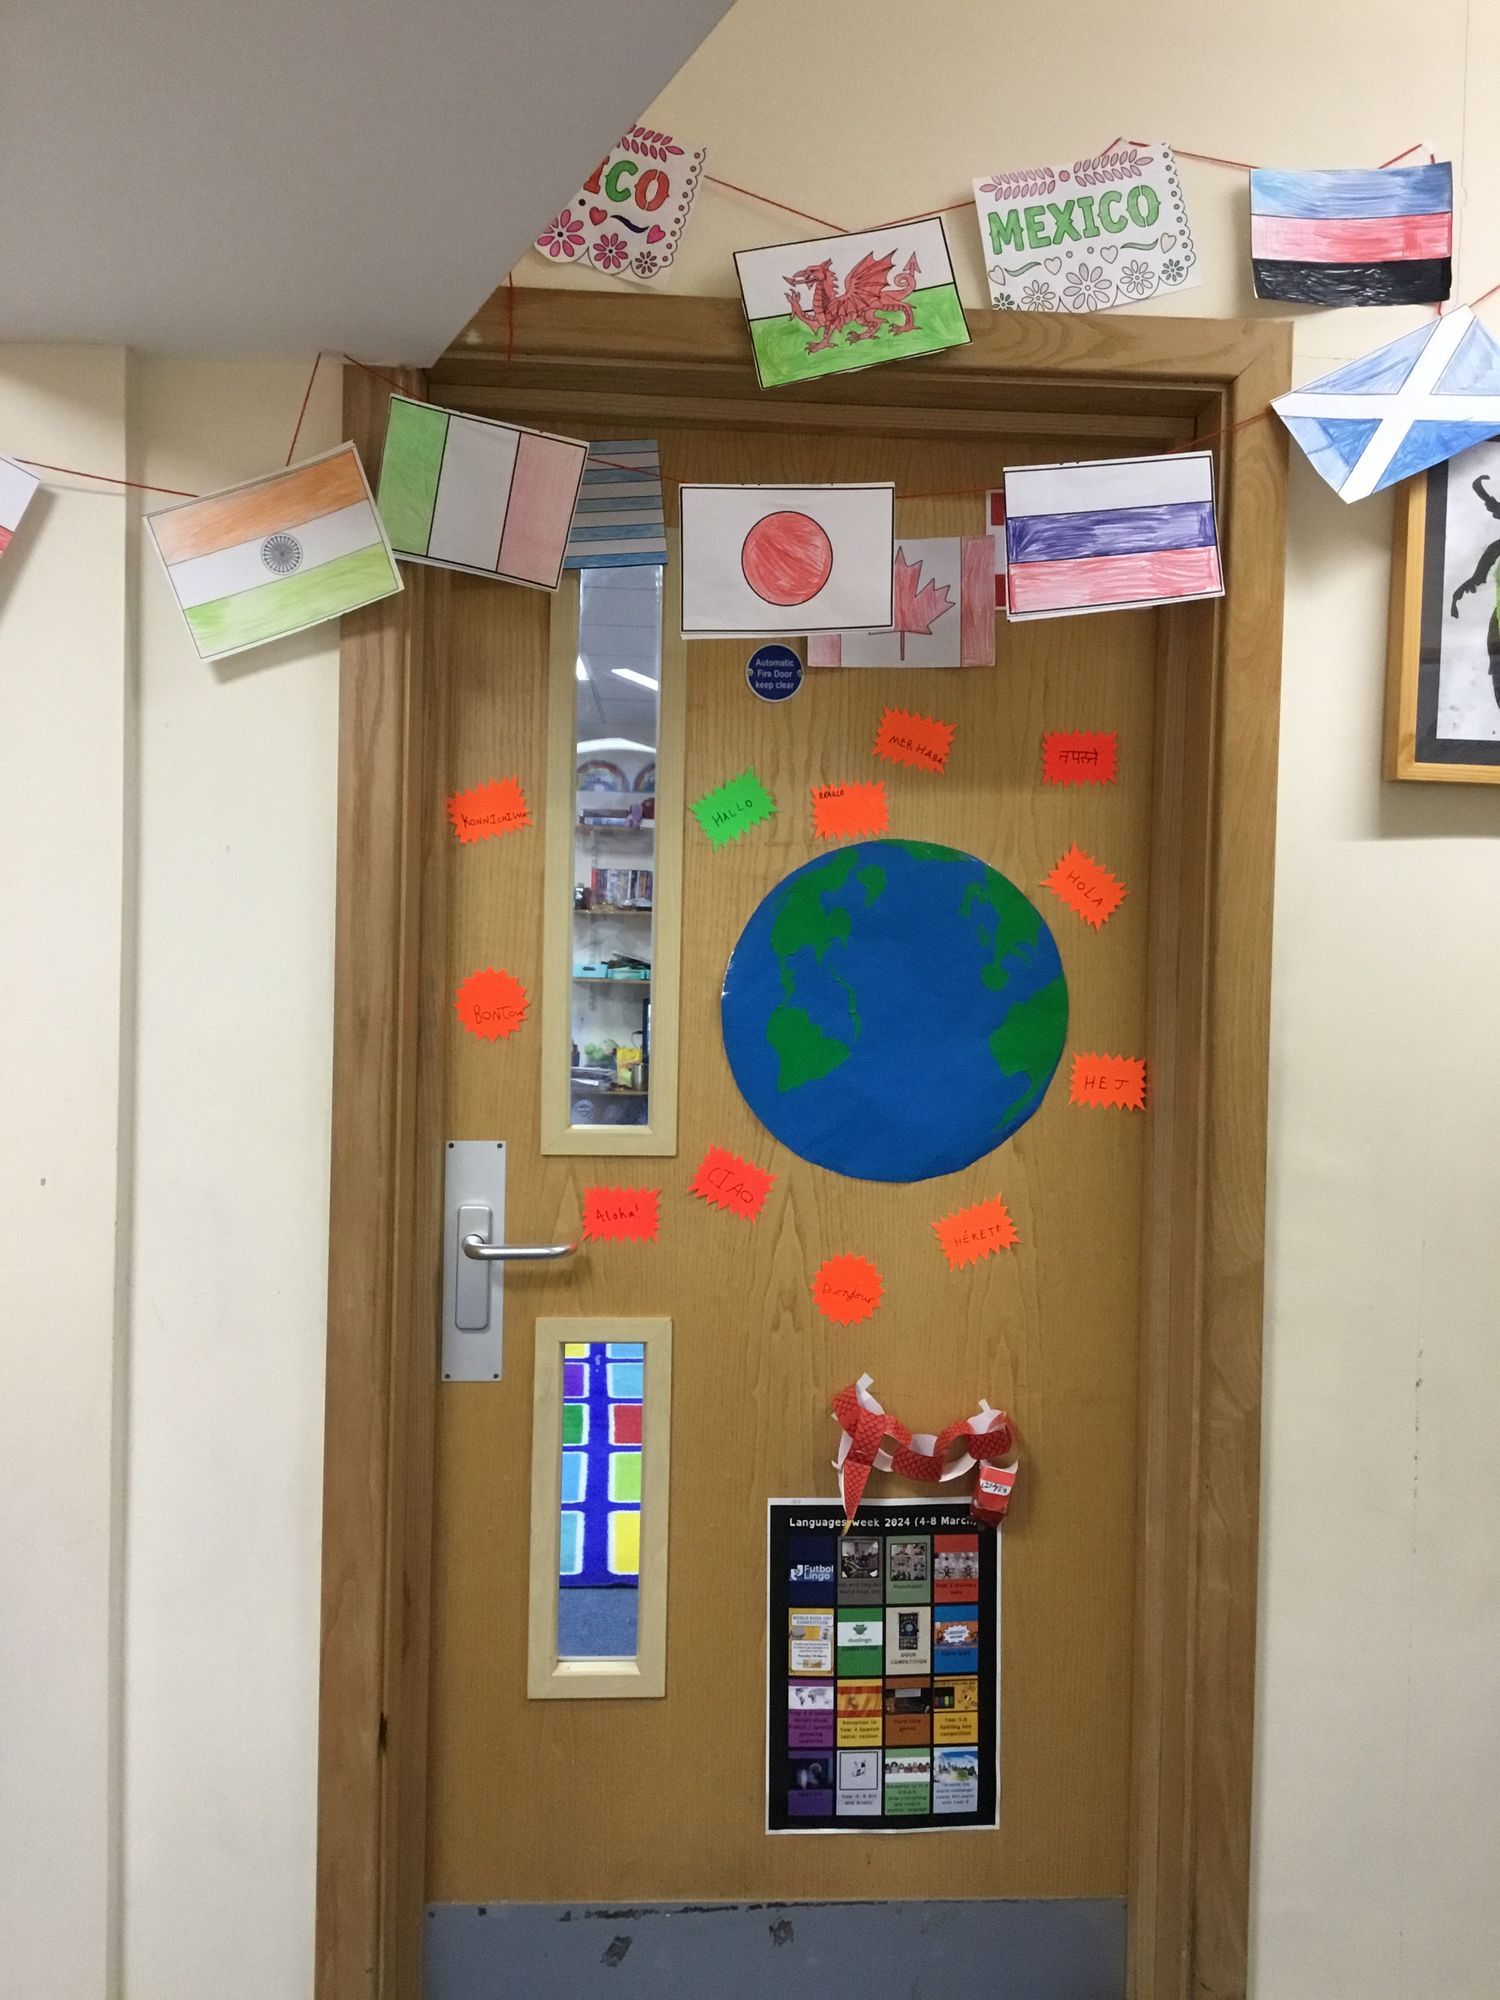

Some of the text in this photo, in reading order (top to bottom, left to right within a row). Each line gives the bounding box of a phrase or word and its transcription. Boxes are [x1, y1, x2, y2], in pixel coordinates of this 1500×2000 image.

[987, 184, 1162, 255] MEXICO
[755, 658, 794, 667] Automatic
[757, 669, 793, 678] Fire Door
[755, 681, 795, 691] keep clear
[711, 799, 754, 828] HALLO
[1066, 870, 1104, 907] HOLA
[1084, 1075, 1129, 1090] HEJ
[706, 1166, 754, 1204] CIAO
[596, 1203, 640, 1223] Aloha!
[789, 1516, 977, 1529] Languages week 2024 (4-8 Marc
[804, 1564, 834, 1573] Futbol
[804, 1573, 831, 1581] Lingo
